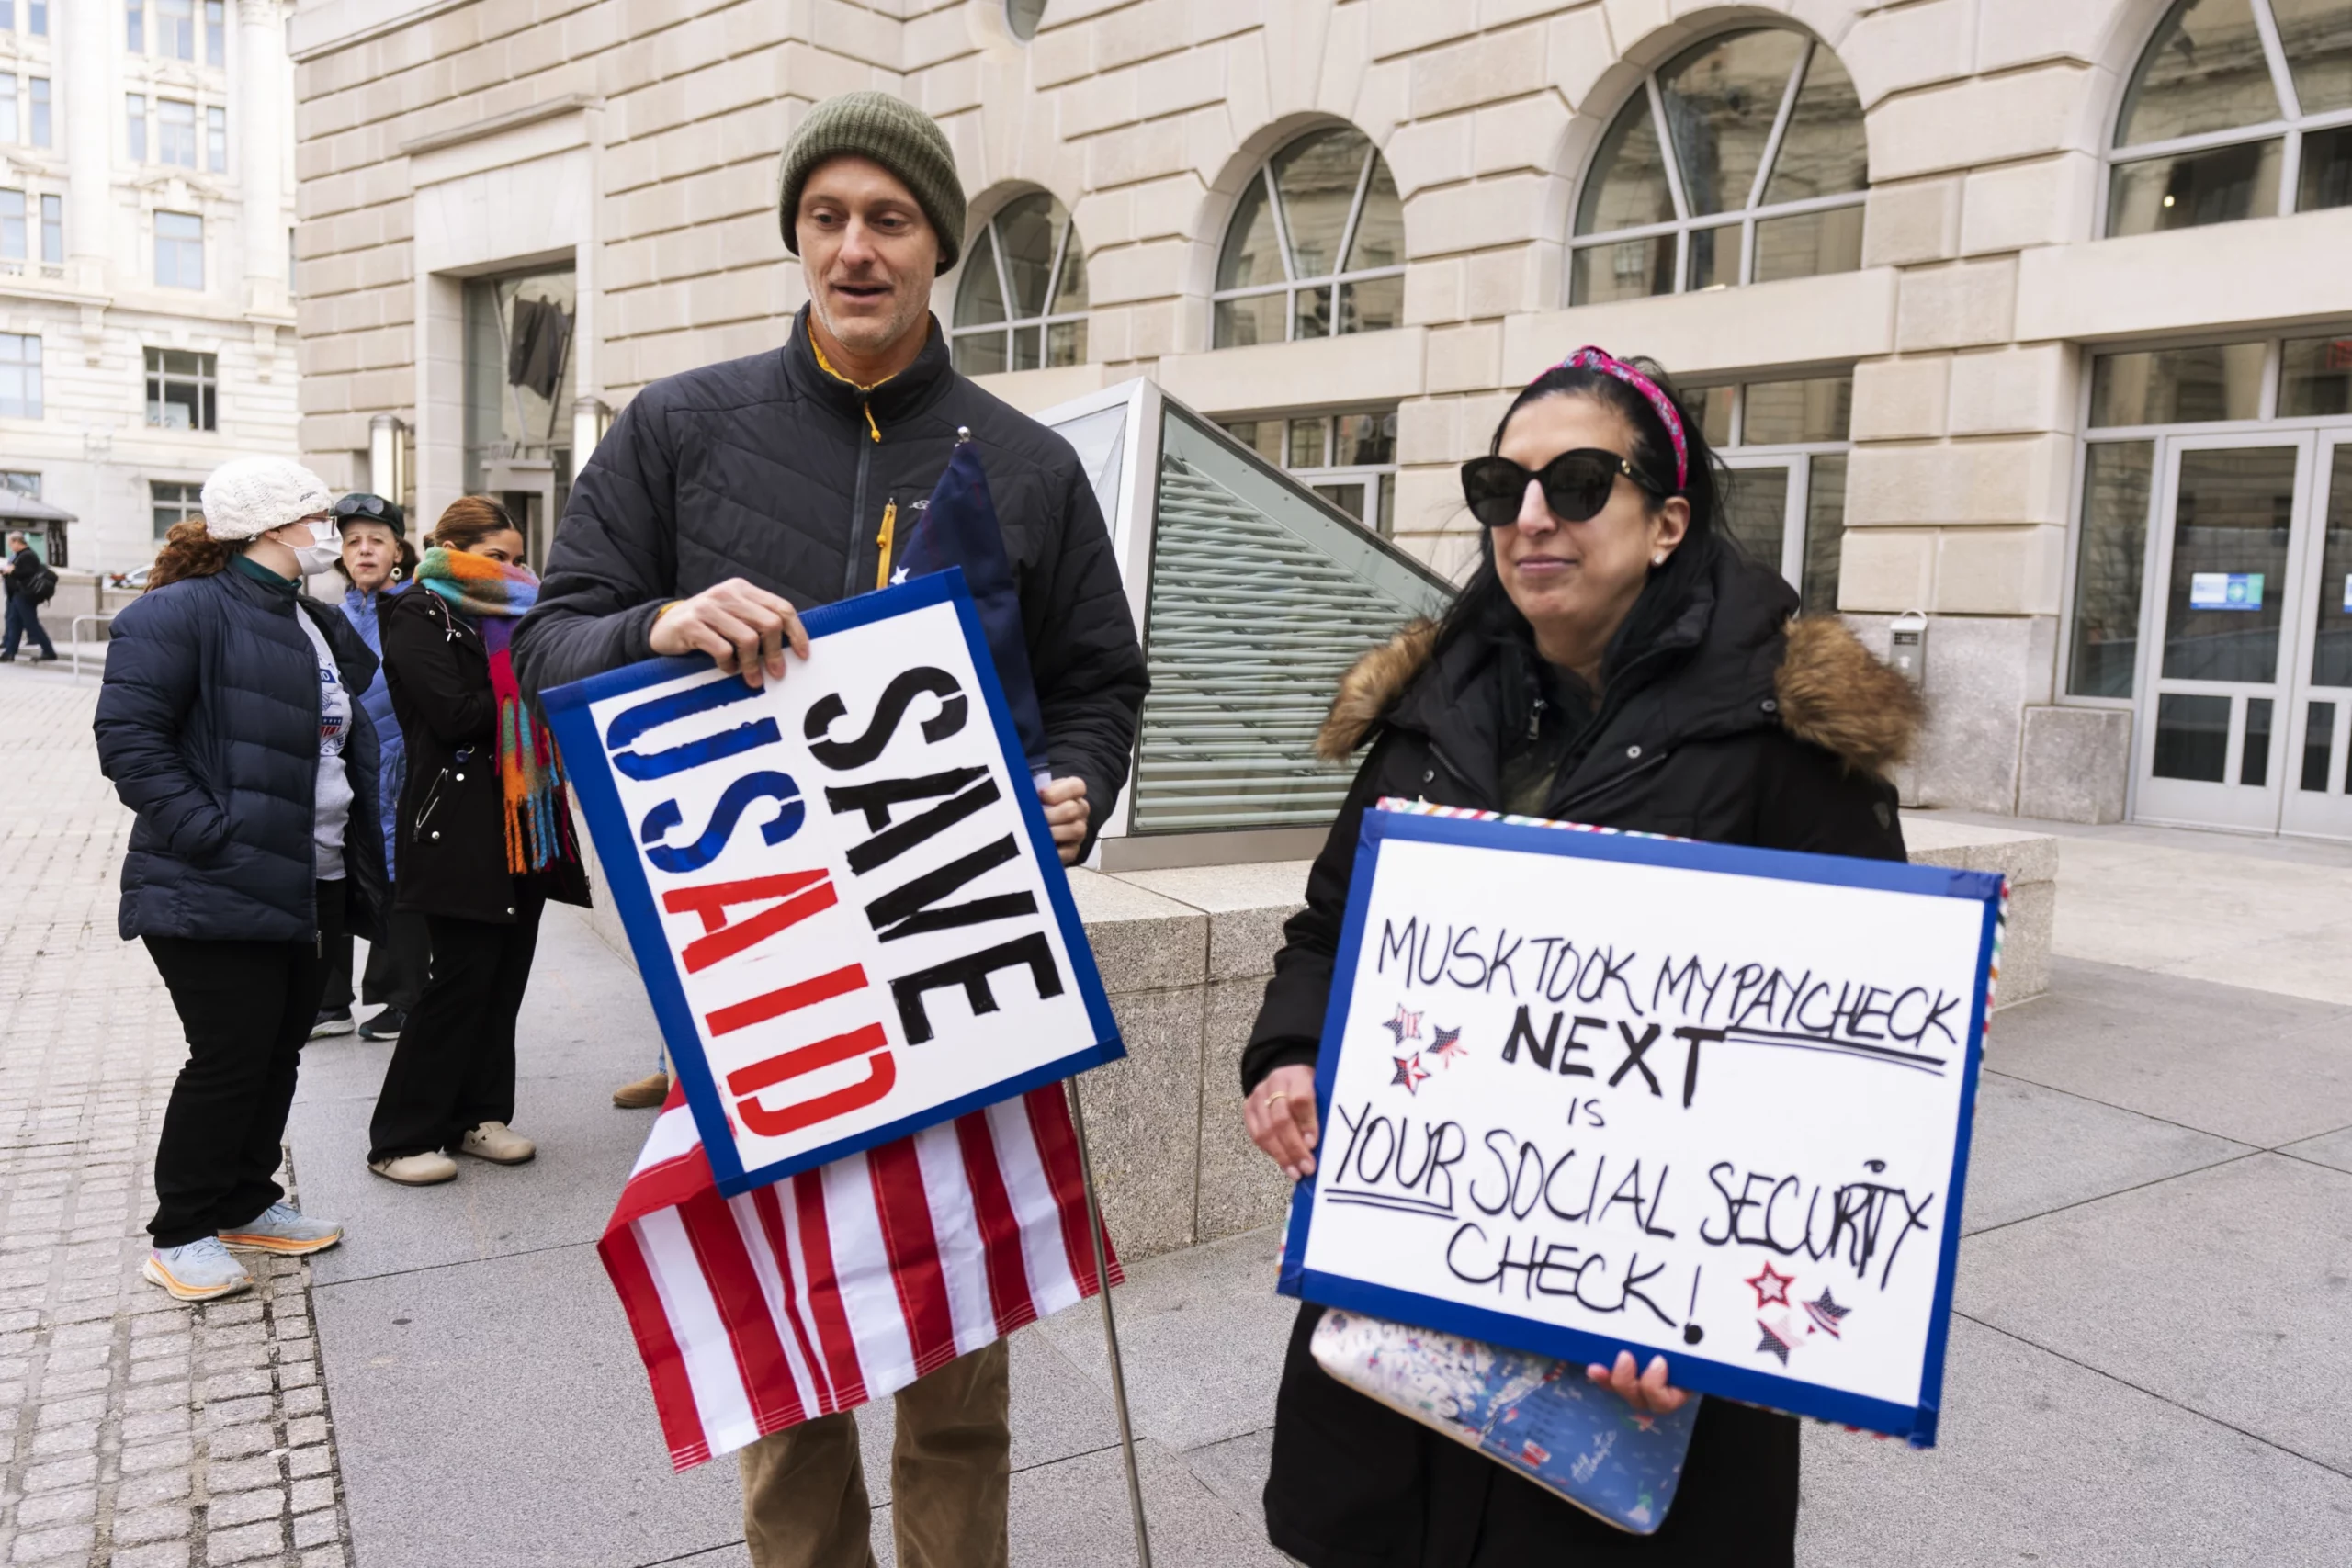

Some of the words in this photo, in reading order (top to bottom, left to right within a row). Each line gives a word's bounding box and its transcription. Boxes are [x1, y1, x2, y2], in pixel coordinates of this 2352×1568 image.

[605, 674, 897, 1138] USAID
[803, 665, 1065, 1046] SAVE
[1379, 916, 1522, 997] MUSK
[1531, 936, 1644, 1017] TOOK
[1653, 954, 1727, 1024] MY
[1729, 962, 1961, 1048] PAYCHECK
[1502, 1004, 1726, 1110] NEXT
[1567, 1097, 1606, 1128] IS
[1335, 1101, 1467, 1211] YOUR
[1470, 1128, 1676, 1239] SOCIAL
[1699, 1158, 1935, 1292] SECURITY
[1446, 1222, 1704, 1346] CHECK!
